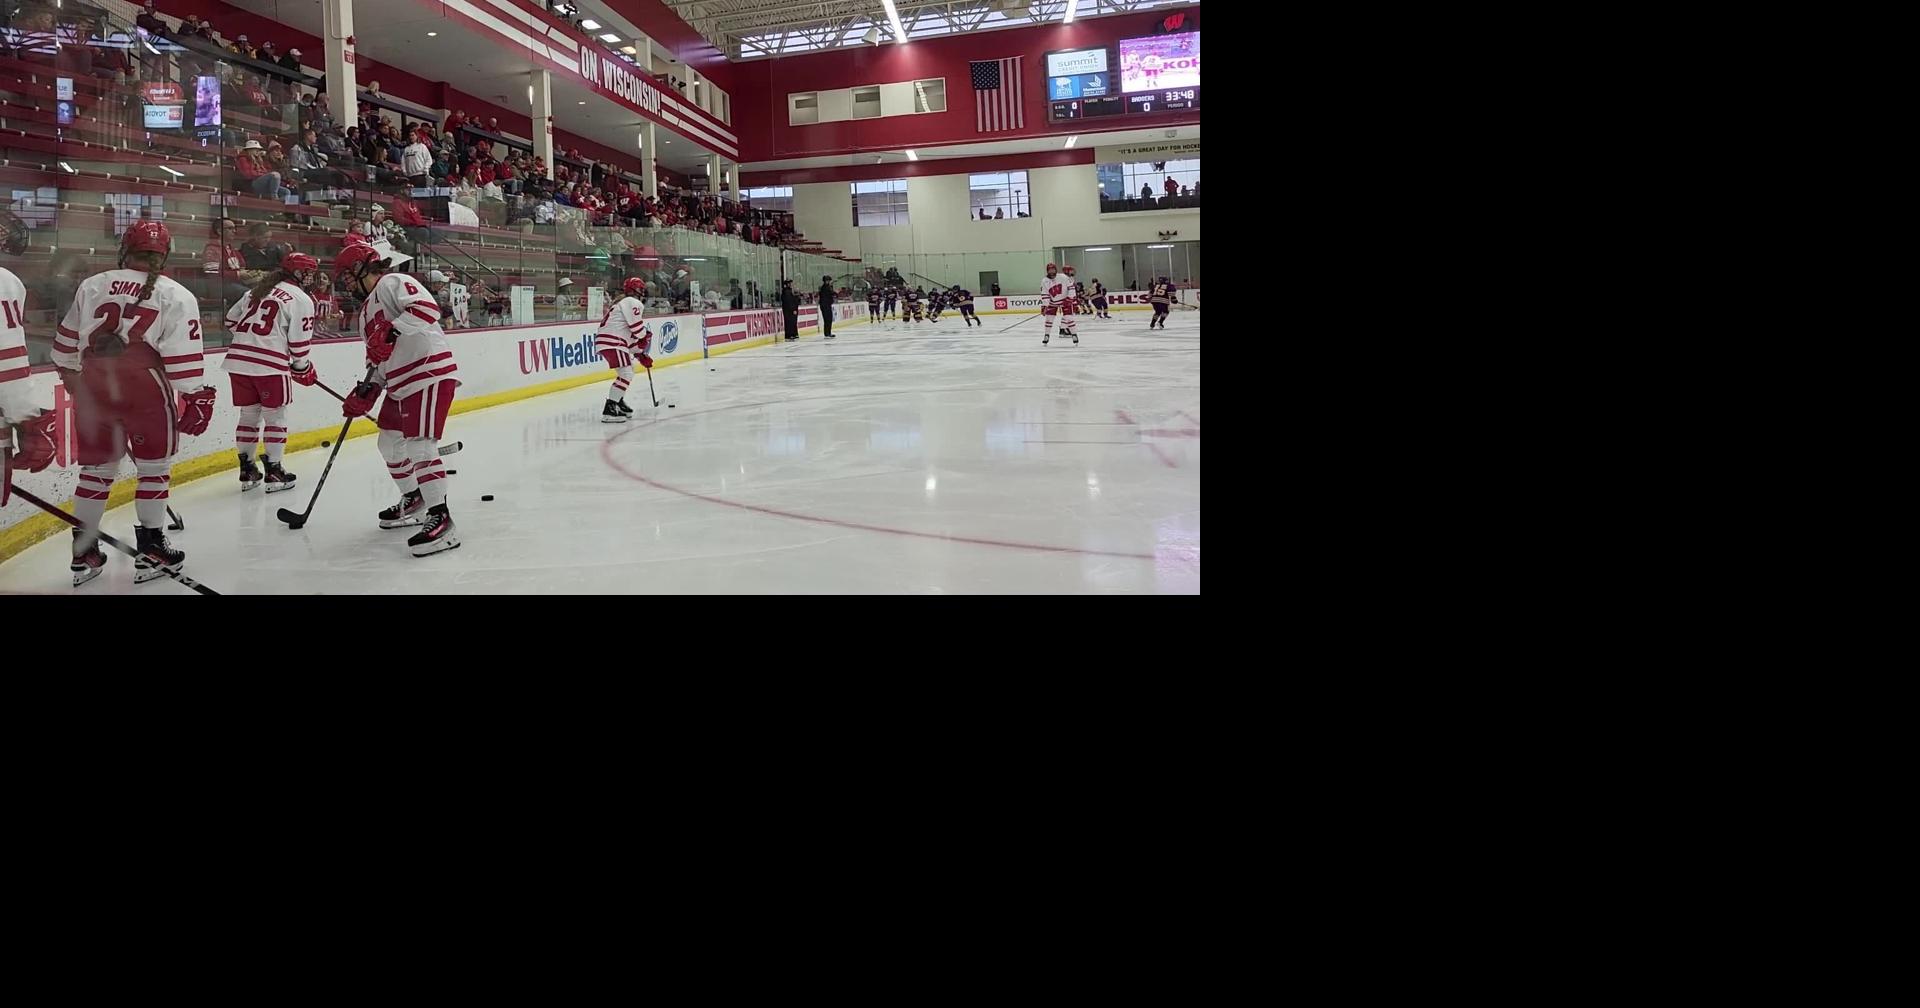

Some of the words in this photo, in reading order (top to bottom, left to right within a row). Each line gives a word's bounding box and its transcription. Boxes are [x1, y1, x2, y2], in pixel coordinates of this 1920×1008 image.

[1057, 55, 1099, 69] summit
[581, 46, 601, 88] ON,
[602, 57, 661, 117] WISCONSIN!
[1165, 90, 1195, 102] 33:48
[1071, 102, 1078, 110] 0
[1143, 102, 1151, 112] 0
[404, 281, 419, 296] 6
[1009, 300, 1043, 308] TOYOTA
[1108, 294, 1151, 305] HL'S
[235, 300, 280, 336] 23
[302, 316, 314, 332] 23
[88, 301, 160, 350] 27
[188, 319, 201, 341] 2
